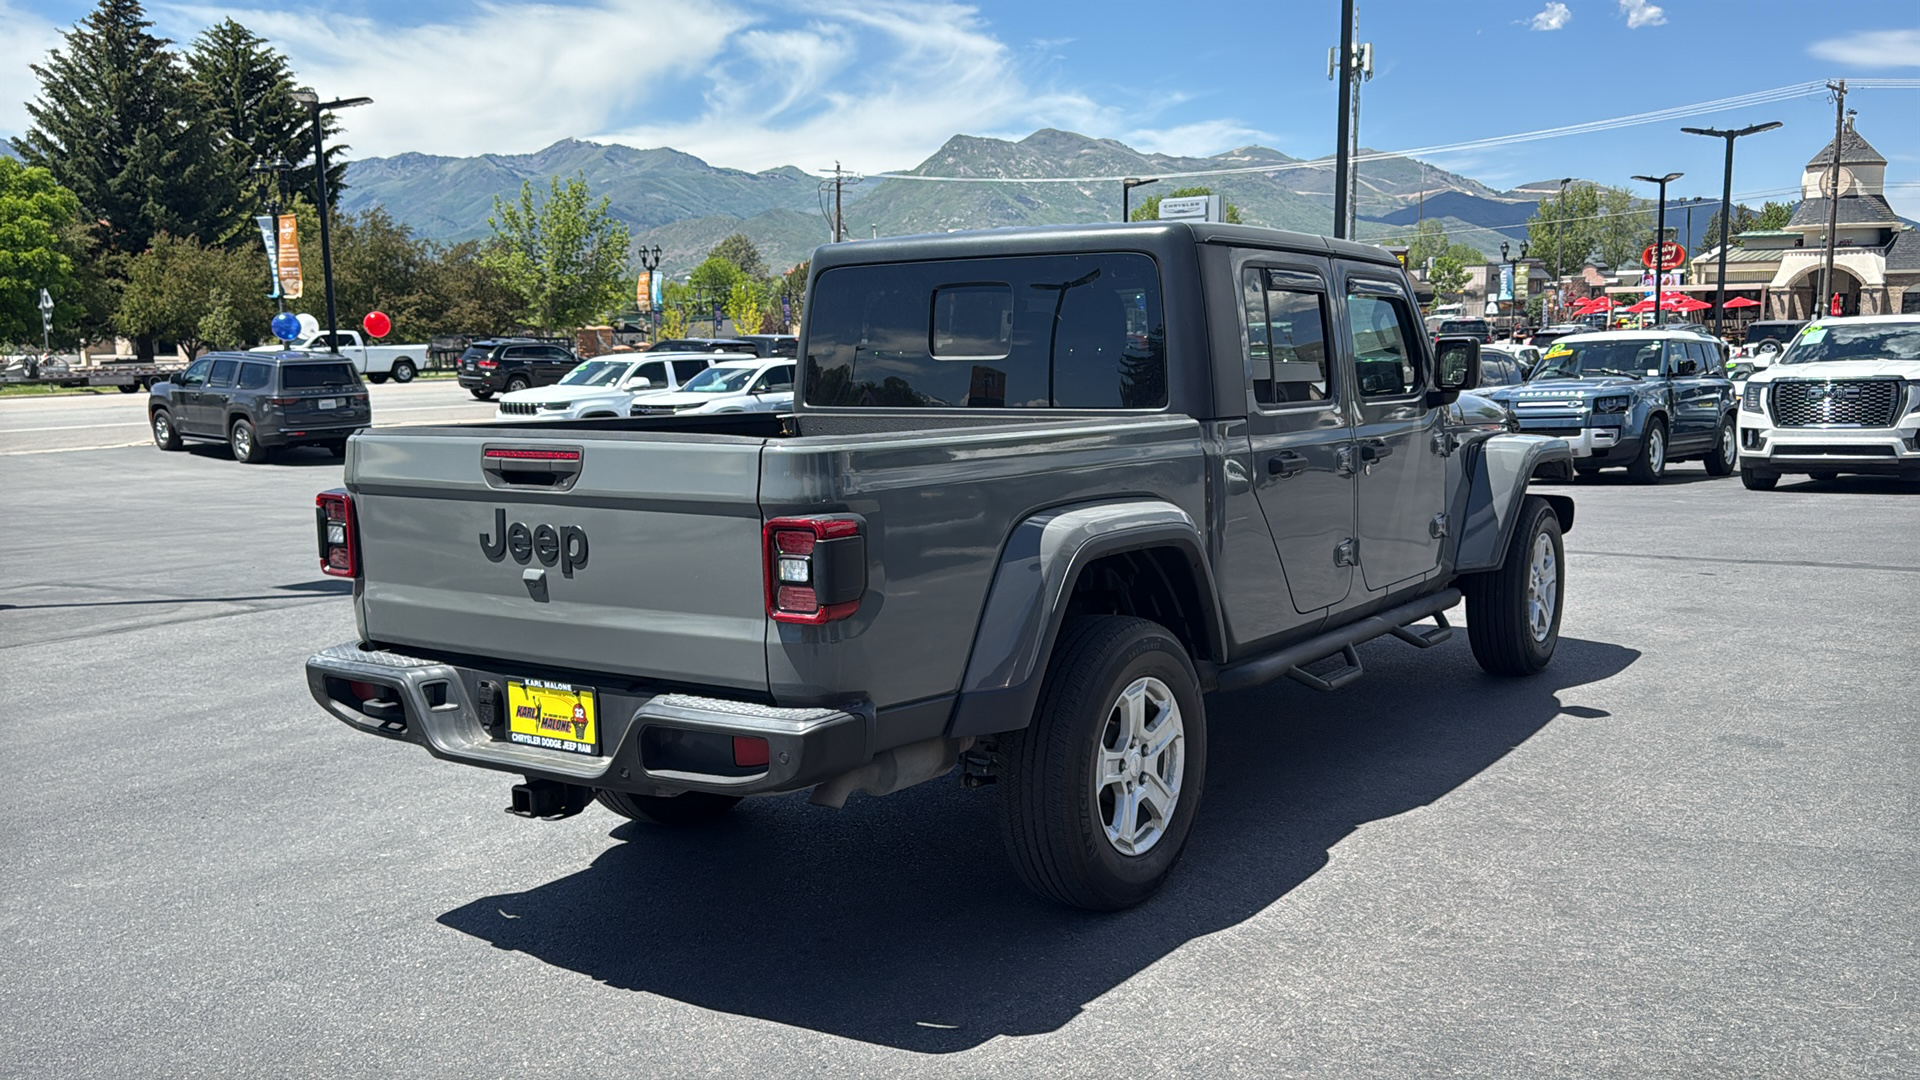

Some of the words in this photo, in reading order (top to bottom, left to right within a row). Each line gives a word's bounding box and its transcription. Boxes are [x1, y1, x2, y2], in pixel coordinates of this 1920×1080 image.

[1806, 388, 1860, 399] GMC
[479, 508, 589, 579] Jeep
[525, 679, 543, 688] KARL
[544, 681, 572, 691] MALONE
[516, 705, 538, 720] KARL
[574, 707, 584, 718] 32
[541, 717, 572, 733] MALONE
[511, 733, 541, 745] CHRYSLER
[542, 738, 562, 749] DODGE
[563, 741, 577, 751] JEEP
[578, 743, 591, 753] RAM
